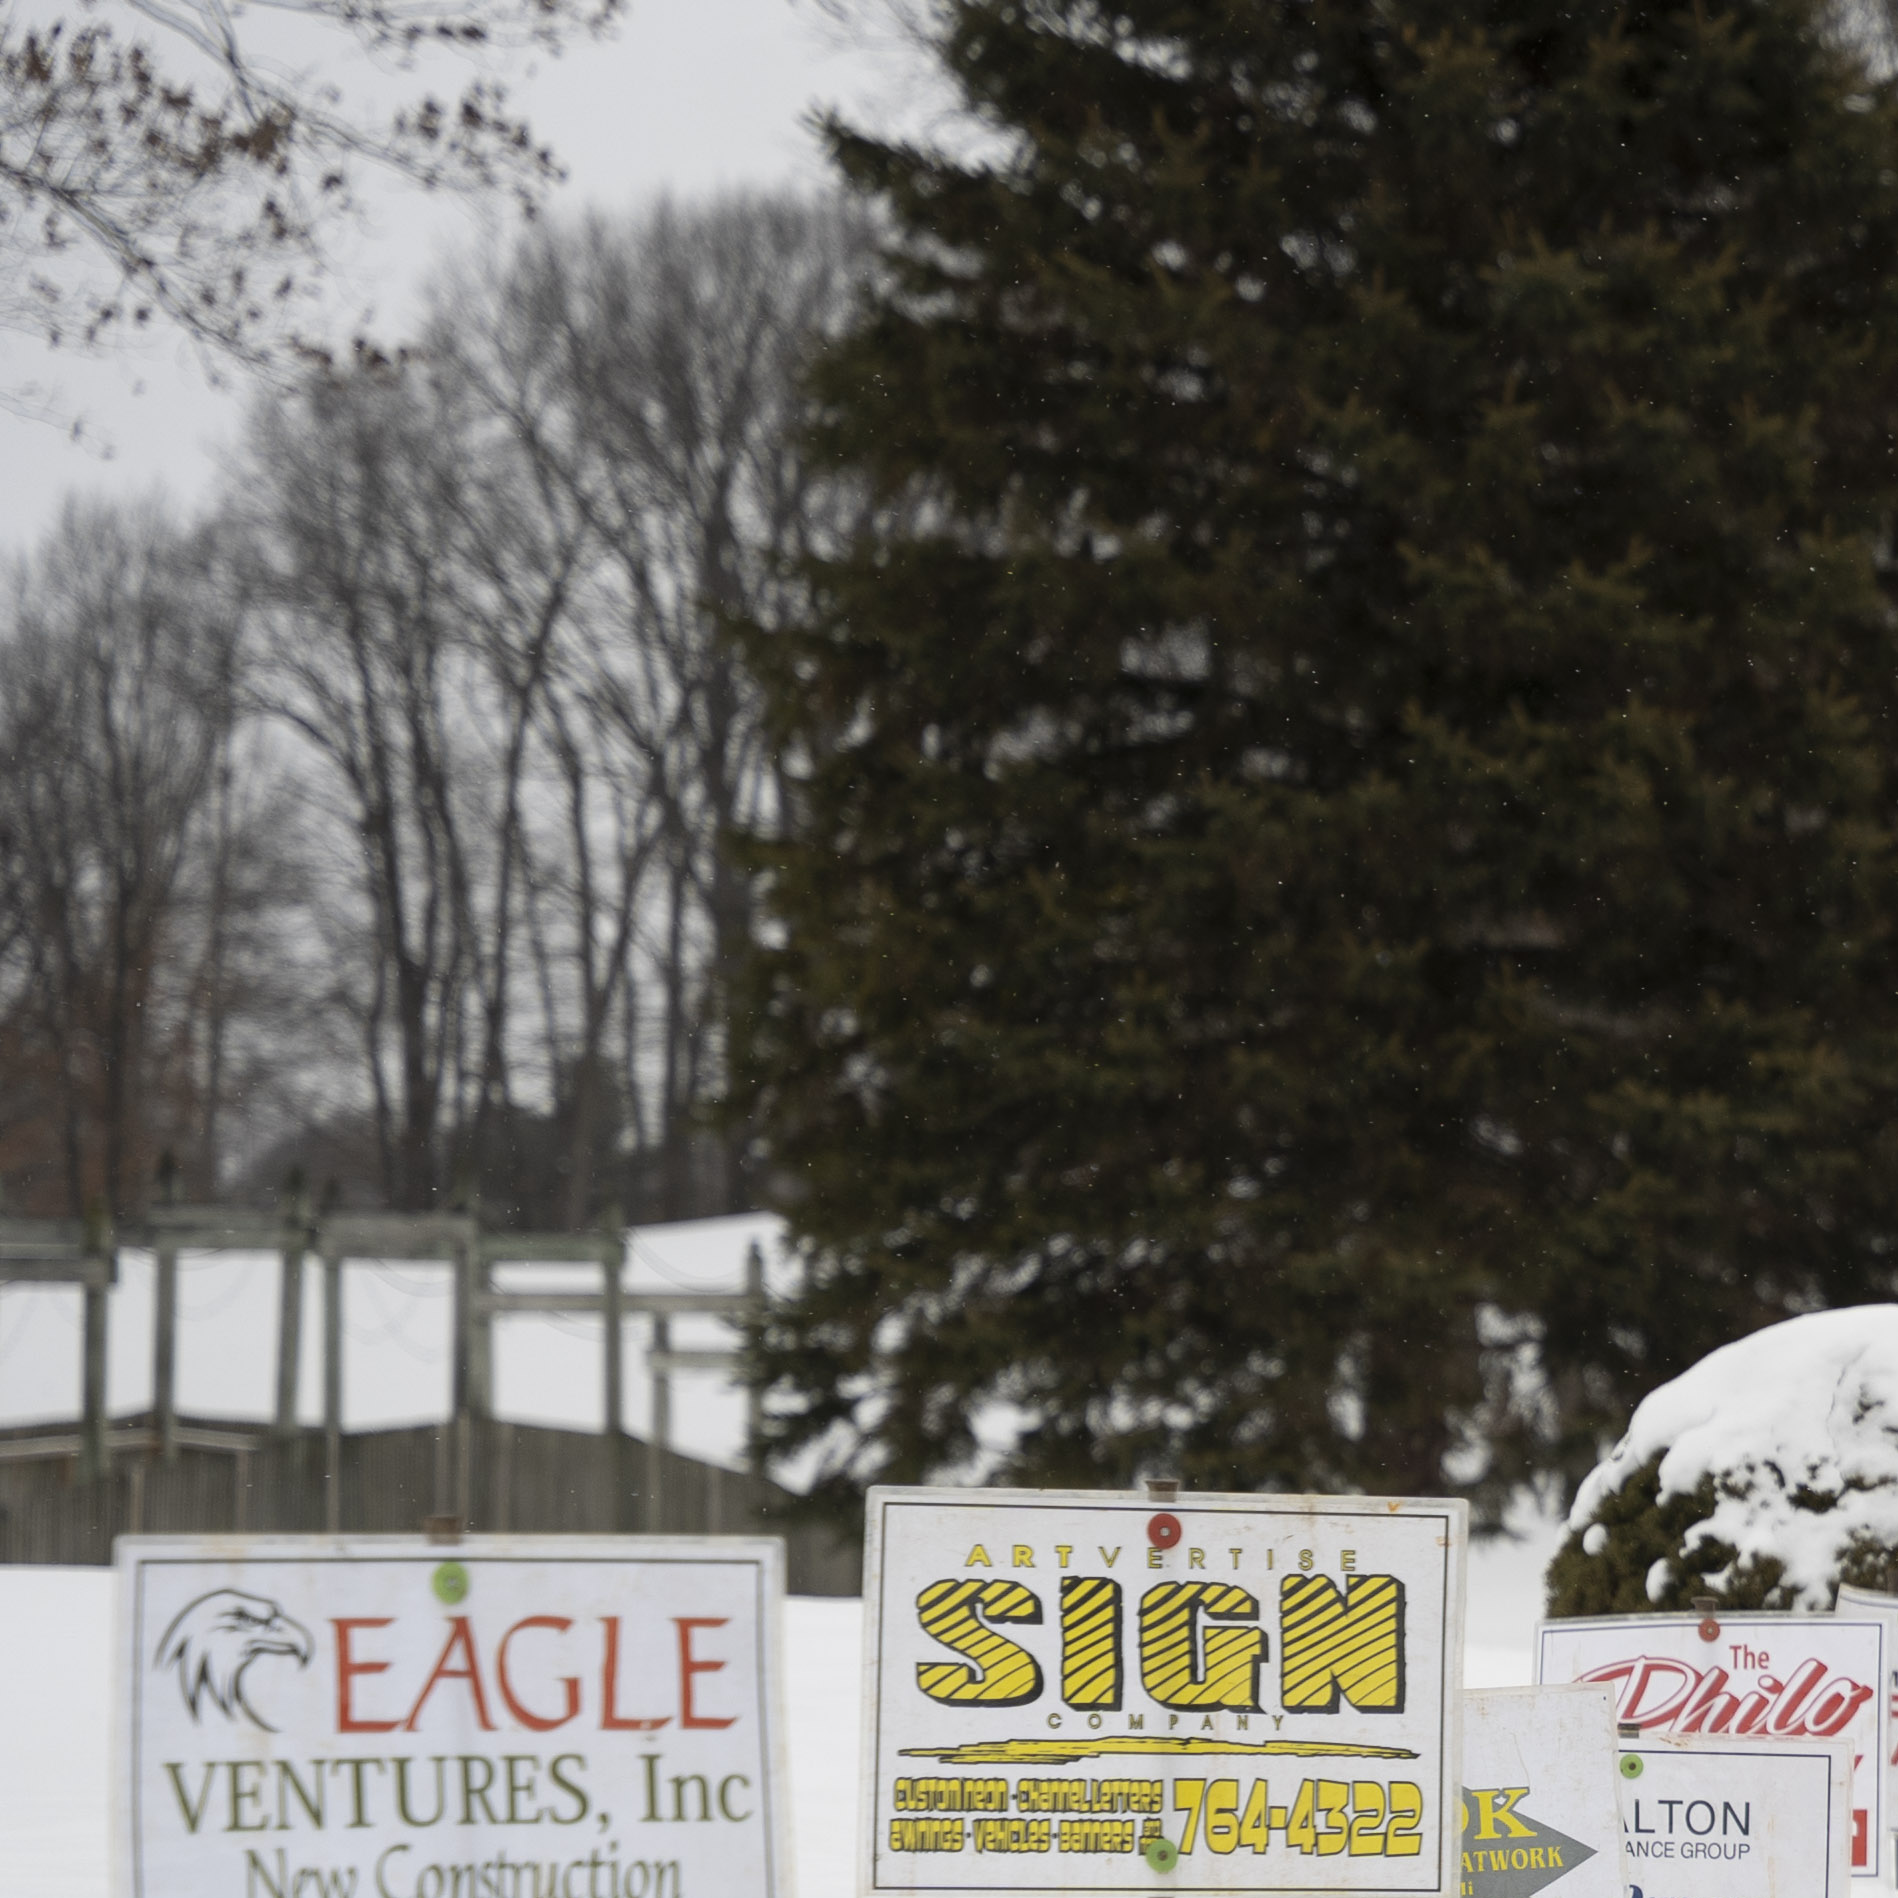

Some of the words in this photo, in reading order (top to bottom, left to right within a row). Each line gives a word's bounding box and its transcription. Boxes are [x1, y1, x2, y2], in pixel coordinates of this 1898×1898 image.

[916, 1573, 1406, 1714] SIGN
[1729, 1645, 1770, 1670] The
[331, 1616, 738, 1733] EAGLE
[1047, 1712, 1285, 1732] COMPANY
[164, 1752, 610, 1834] VENTURES,
[640, 1753, 754, 1823] Inc
[1173, 1778, 1423, 1856] 764-4322
[1623, 1799, 1750, 1836] LTON
[1462, 1846, 1564, 1873] ATWORK
[1681, 1842, 1750, 1860] GROUP
